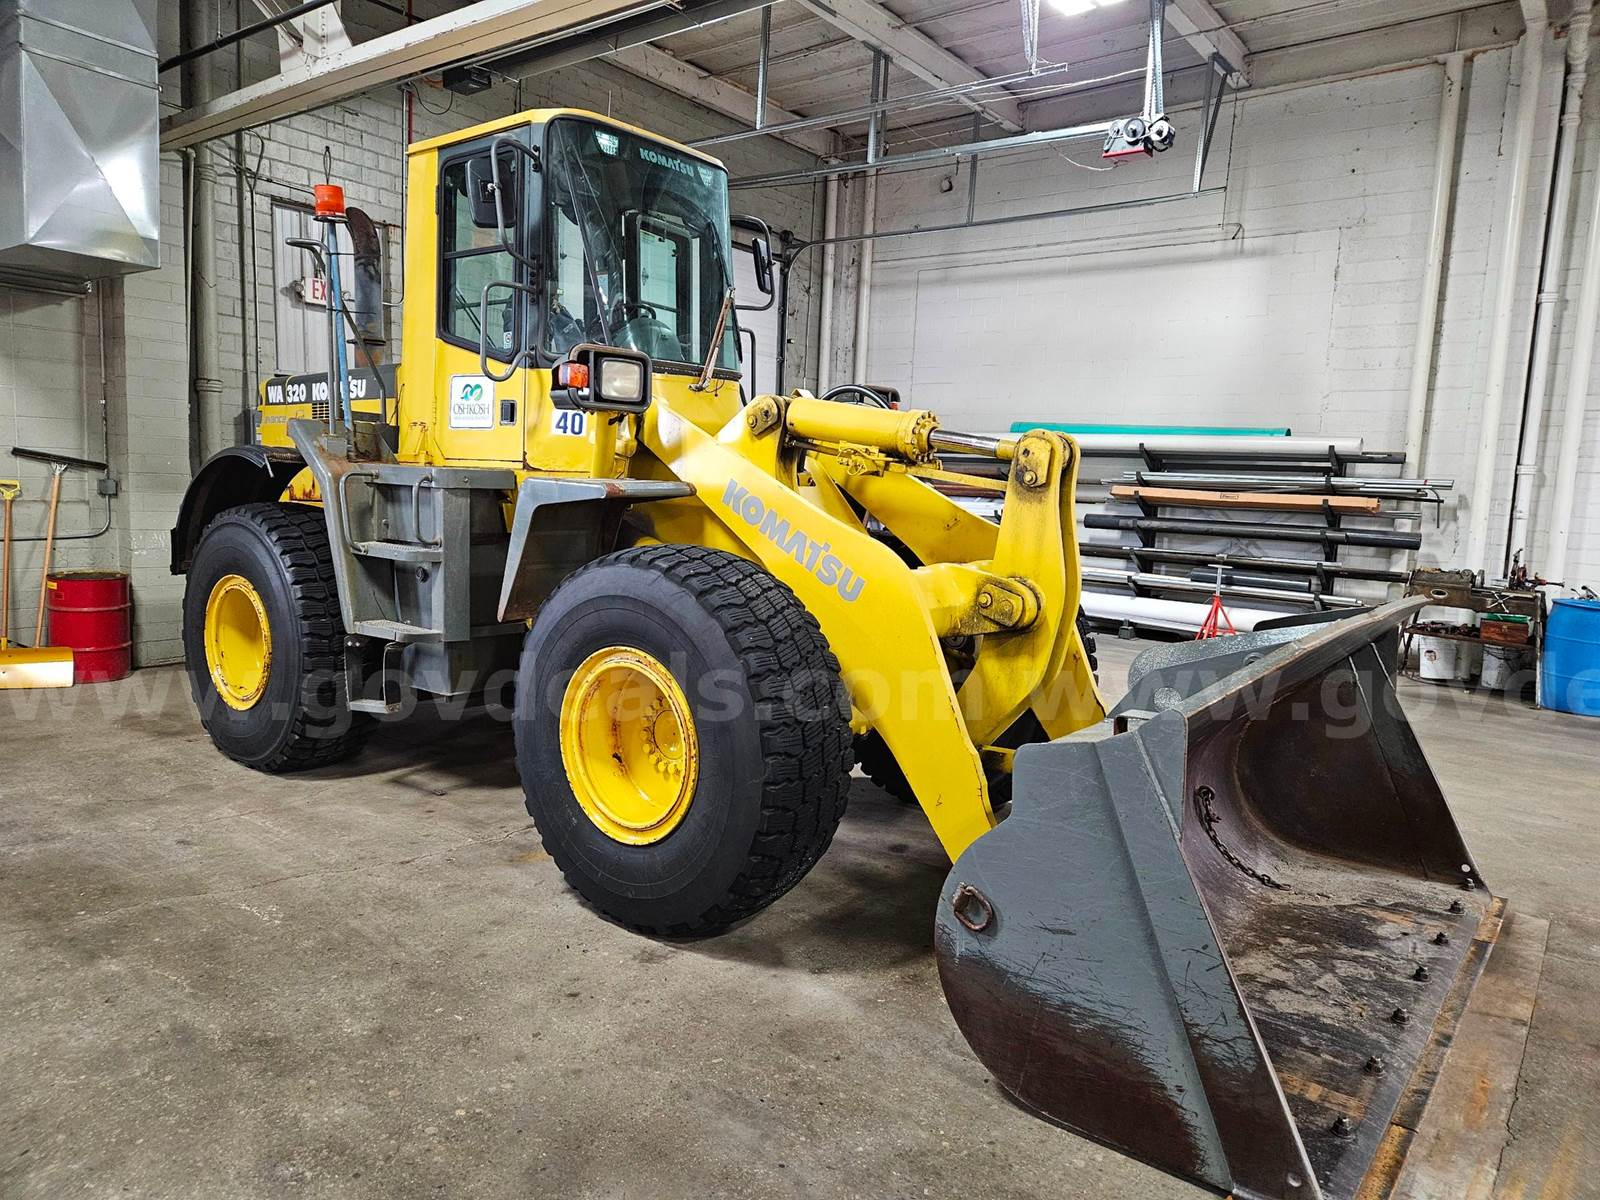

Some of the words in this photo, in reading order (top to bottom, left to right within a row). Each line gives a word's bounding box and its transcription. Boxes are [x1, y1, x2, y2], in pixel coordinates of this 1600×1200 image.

[639, 147, 695, 177] KOMATSU
[267, 385, 284, 403] WA
[286, 383, 307, 403] 320
[312, 376, 367, 401] KOSU
[453, 403, 490, 415] OSHKOSH
[555, 411, 584, 435] 40
[721, 478, 866, 602] KOMATSU
